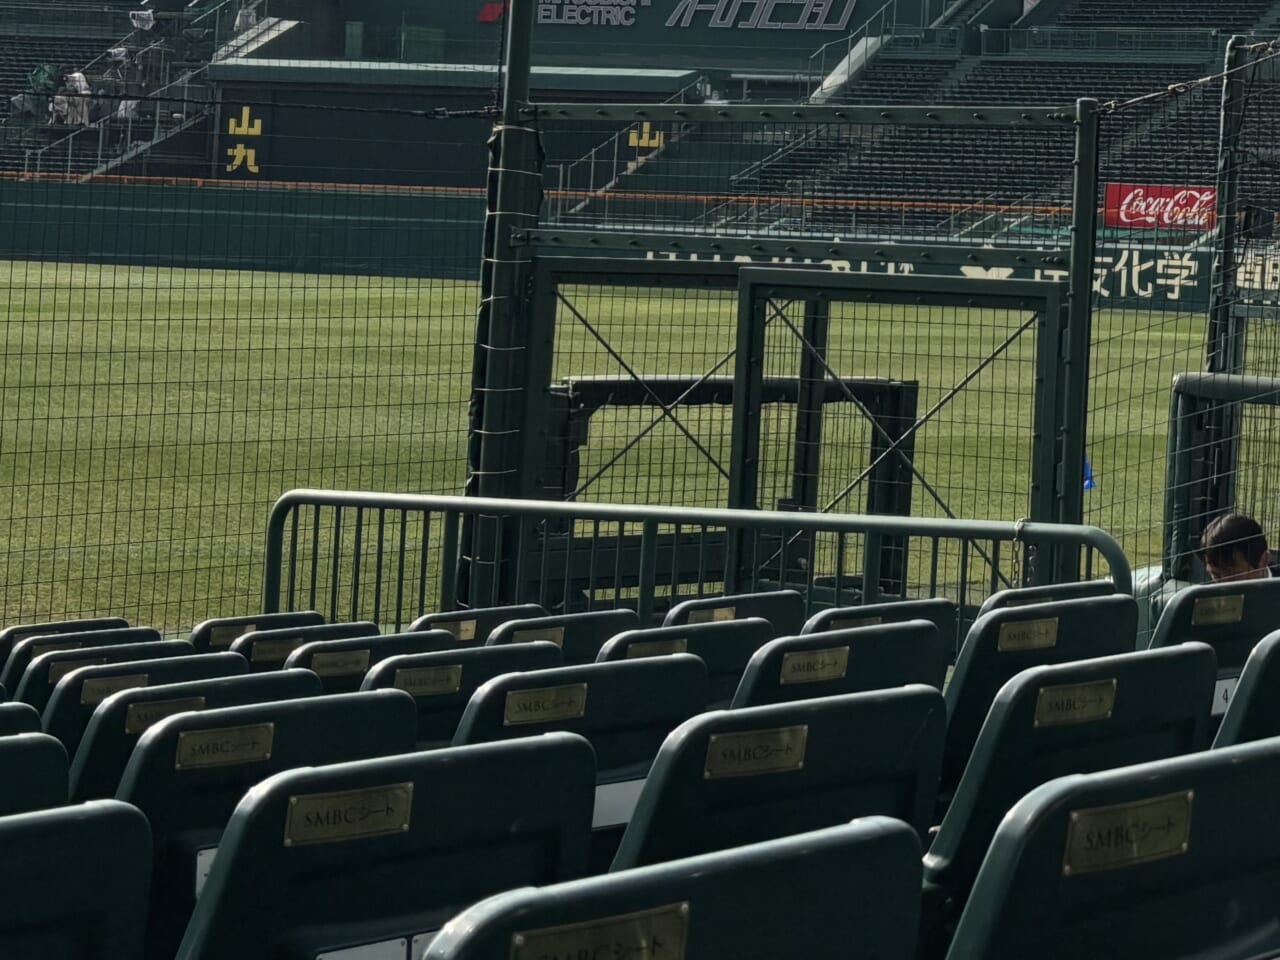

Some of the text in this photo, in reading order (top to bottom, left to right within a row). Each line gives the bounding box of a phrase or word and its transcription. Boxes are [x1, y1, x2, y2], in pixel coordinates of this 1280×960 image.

[538, 5, 636, 26] ELECTRIC
[226, 106, 262, 173] 山九
[304, 804, 396, 830] SMBCシート
[1084, 813, 1177, 851] SMBCシート
